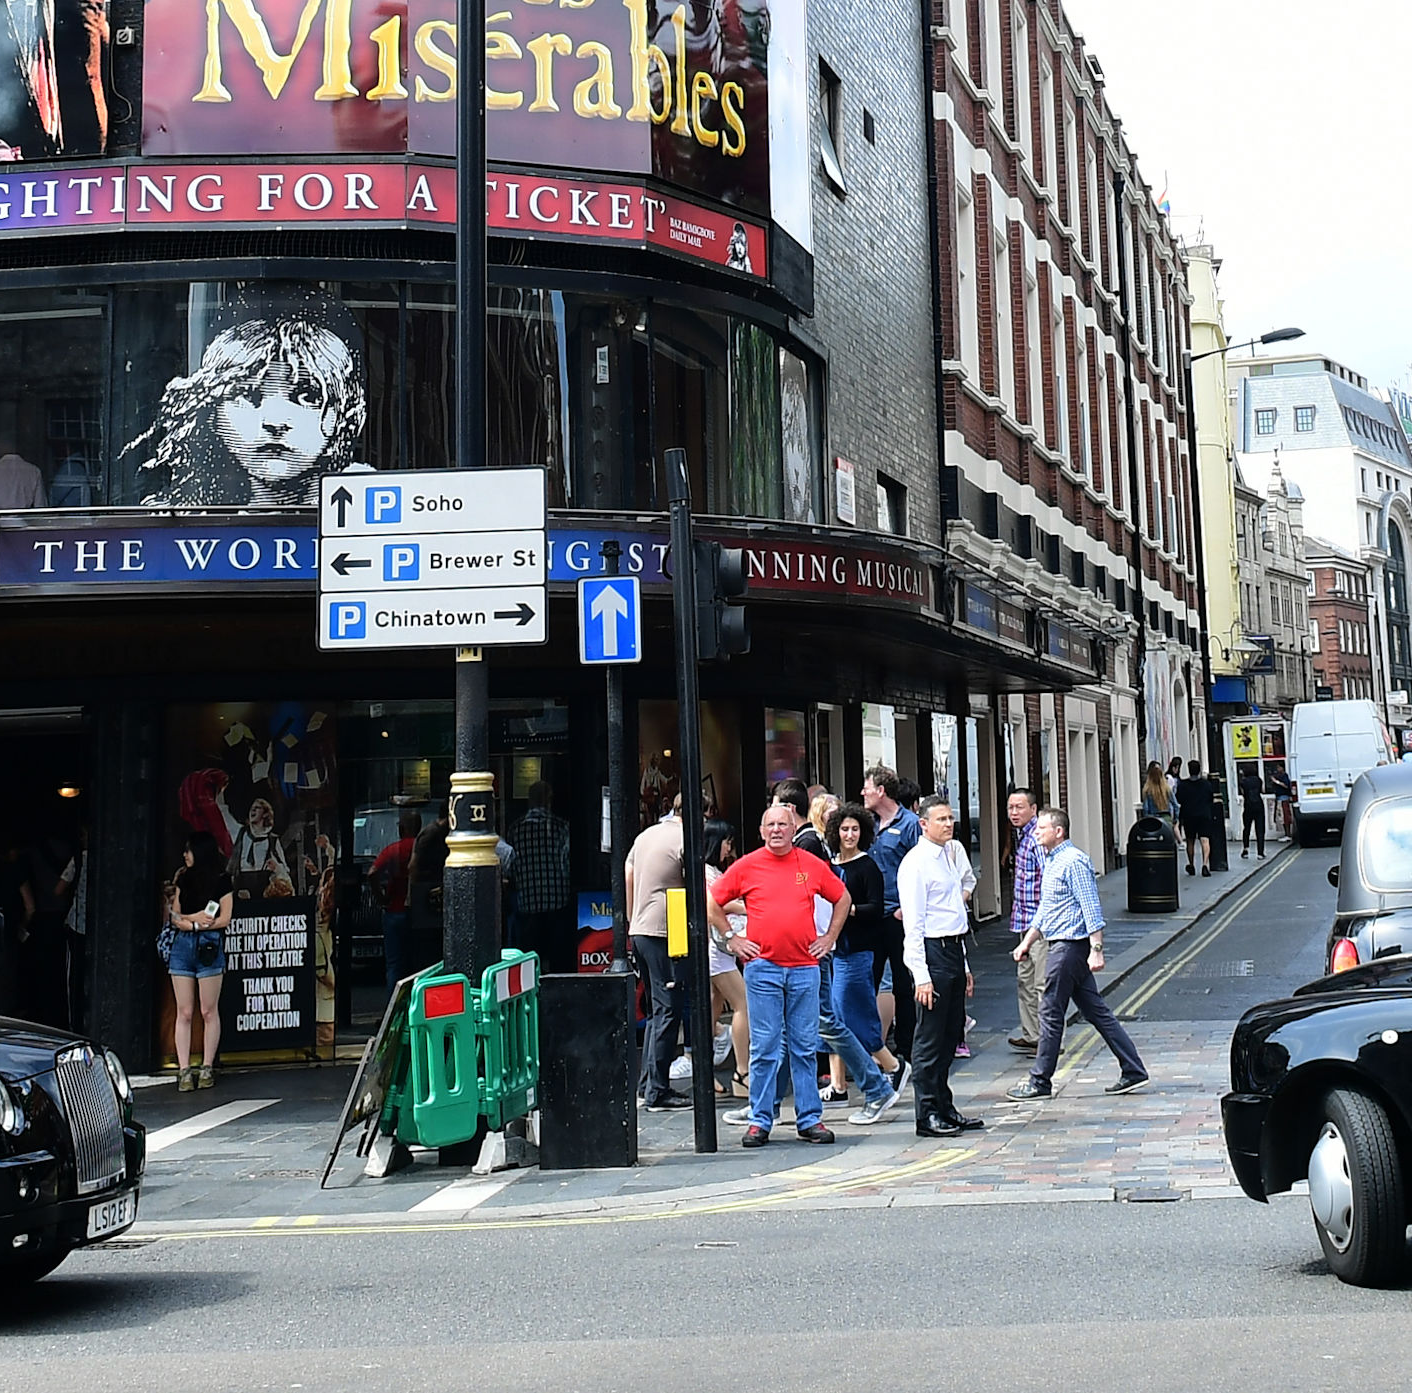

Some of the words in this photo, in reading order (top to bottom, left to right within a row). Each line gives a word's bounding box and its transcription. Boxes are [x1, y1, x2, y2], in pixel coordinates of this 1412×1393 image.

[256, 172, 380, 212] FOR
[407, 174, 439, 213] A
[485, 178, 667, 233] ICKET’
[669, 229, 687, 244] DAILY
[687, 234, 703, 248] MAIL
[373, 490, 397, 522] P
[412, 494, 463, 512] Soho
[32, 539, 146, 574] THE
[174, 538, 319, 571] WOR
[746, 549, 847, 584] NNING
[856, 559, 924, 597] MUSICAL
[391, 547, 415, 579] P
[430, 553, 504, 570] Brewer
[512, 549, 536, 567] St
[337, 605, 362, 637] P
[375, 610, 486, 628] Chinatown
[225, 916, 269, 935] SECURITY
[270, 914, 307, 933] CHECKS
[224, 935, 242, 953] ARE
[244, 935, 255, 951] IN
[256, 932, 307, 951] OPERATION
[228, 954, 239, 970] AT
[241, 952, 263, 970] THIS
[264, 950, 304, 968] THEATRE
[581, 952, 611, 965] BOX
[242, 977, 274, 995] THANK
[275, 975, 294, 993] YOU
[246, 995, 264, 1013] FOR
[266, 994, 291, 1011] YOUR
[236, 1011, 300, 1031] COOPERATION
[94, 1203, 116, 1232] LS12
